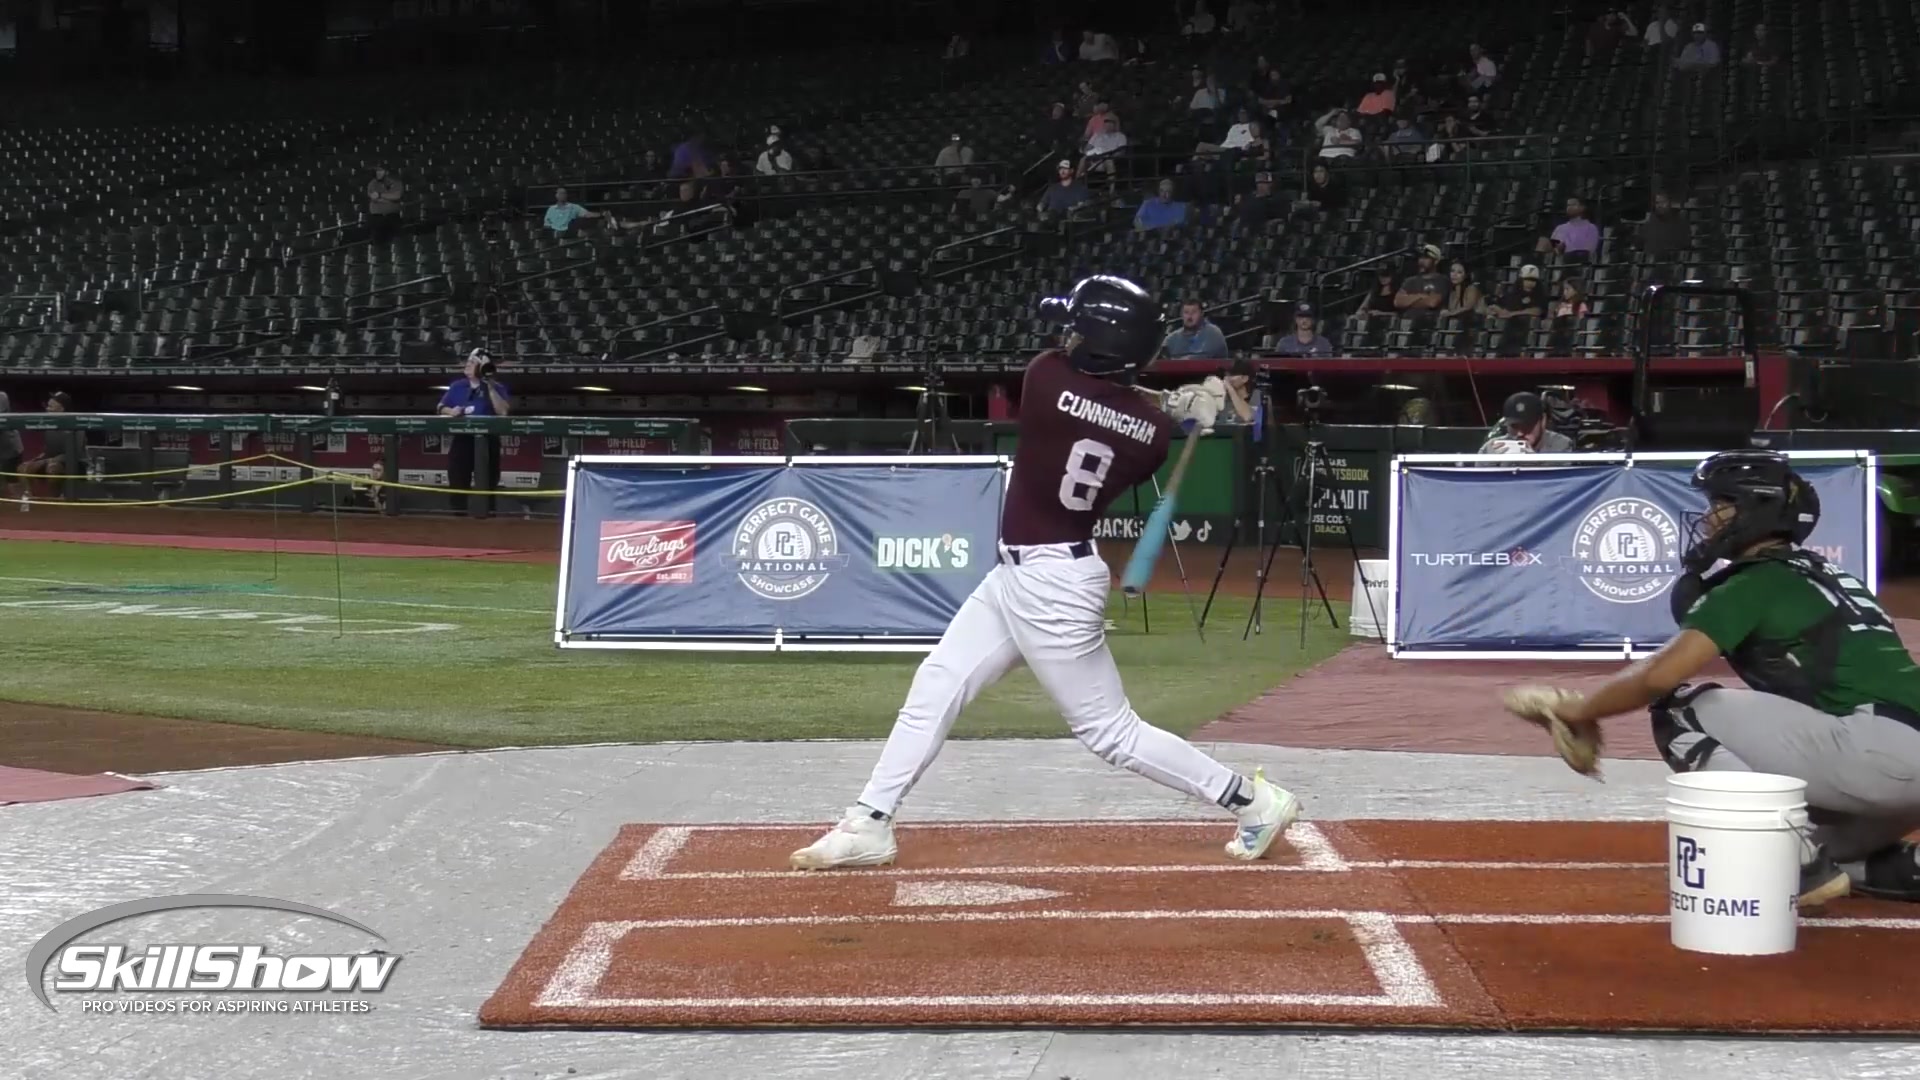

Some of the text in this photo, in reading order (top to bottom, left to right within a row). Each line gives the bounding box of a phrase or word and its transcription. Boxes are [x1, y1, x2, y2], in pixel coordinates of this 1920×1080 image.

[1057, 390, 1157, 445] CUNNINGHAM
[1059, 438, 1115, 511] 8
[740, 502, 832, 544] PERFECT GAME
[1579, 502, 1677, 546] PERFECT GAME
[607, 535, 688, 563] Rawlings
[878, 533, 969, 568] DICK'S
[1410, 550, 1543, 567] TURTLEBOX
[741, 562, 828, 572] NATIONAL
[1582, 564, 1674, 574] NATIONAL
[750, 575, 816, 593] SHOWCASE
[1592, 577, 1662, 597] SHOWCASE
[1676, 835, 1706, 890] PG
[1703, 898, 1760, 917] GAME
